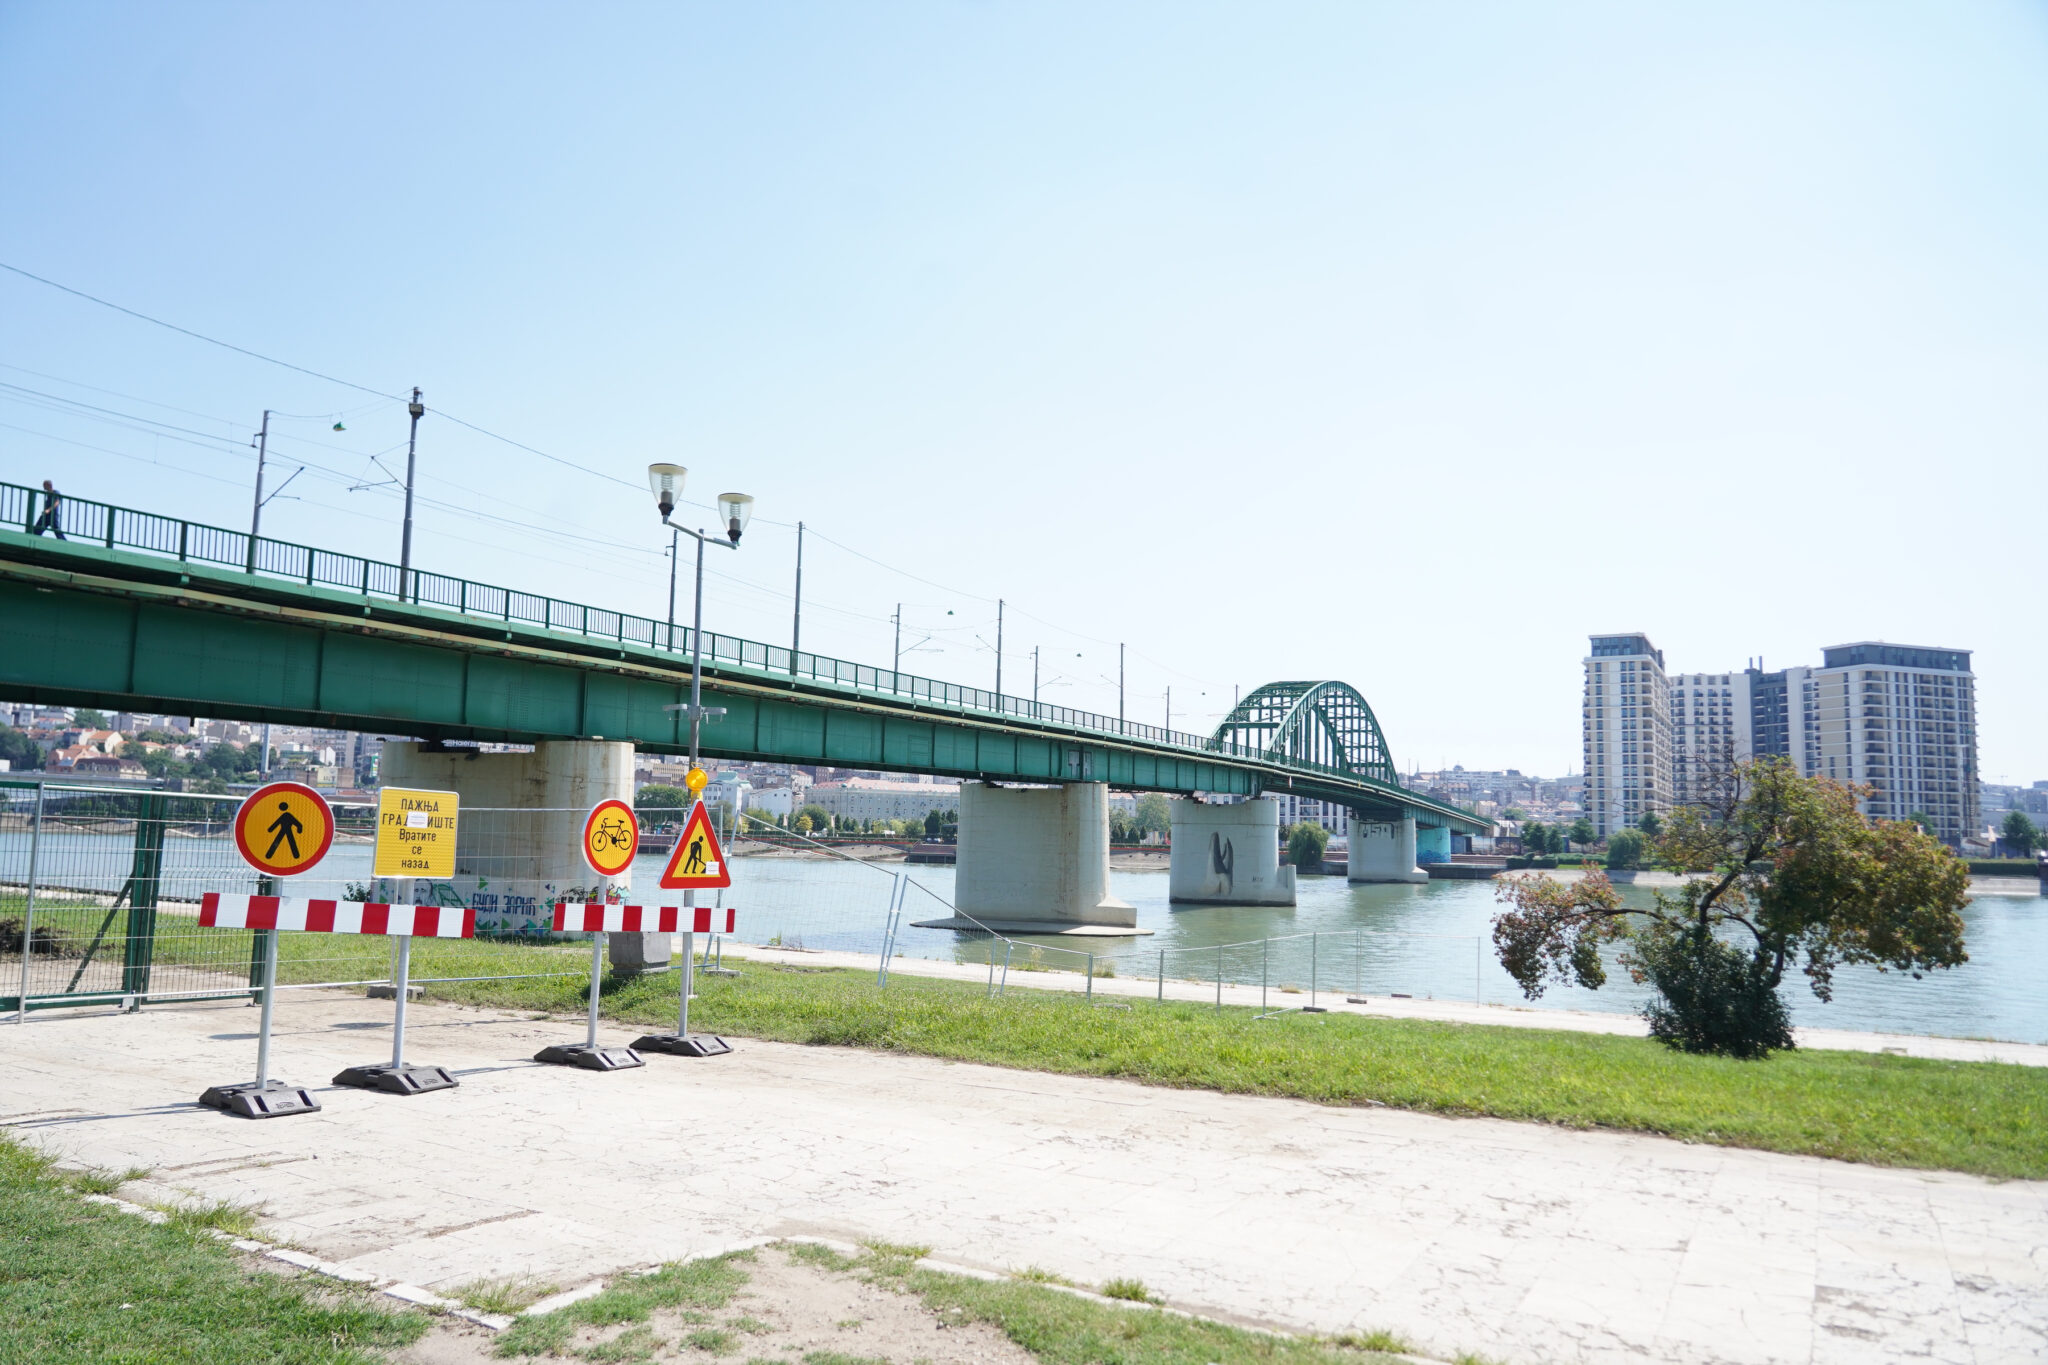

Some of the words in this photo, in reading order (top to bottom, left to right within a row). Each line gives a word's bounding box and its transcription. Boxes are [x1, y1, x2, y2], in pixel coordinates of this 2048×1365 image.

[401, 799, 439, 812] ПАЖЊА
[382, 813, 454, 829] ГРАИШТЕ
[399, 829, 437, 842] Вратите
[411, 845, 422, 855] се
[401, 859, 430, 869] назад
